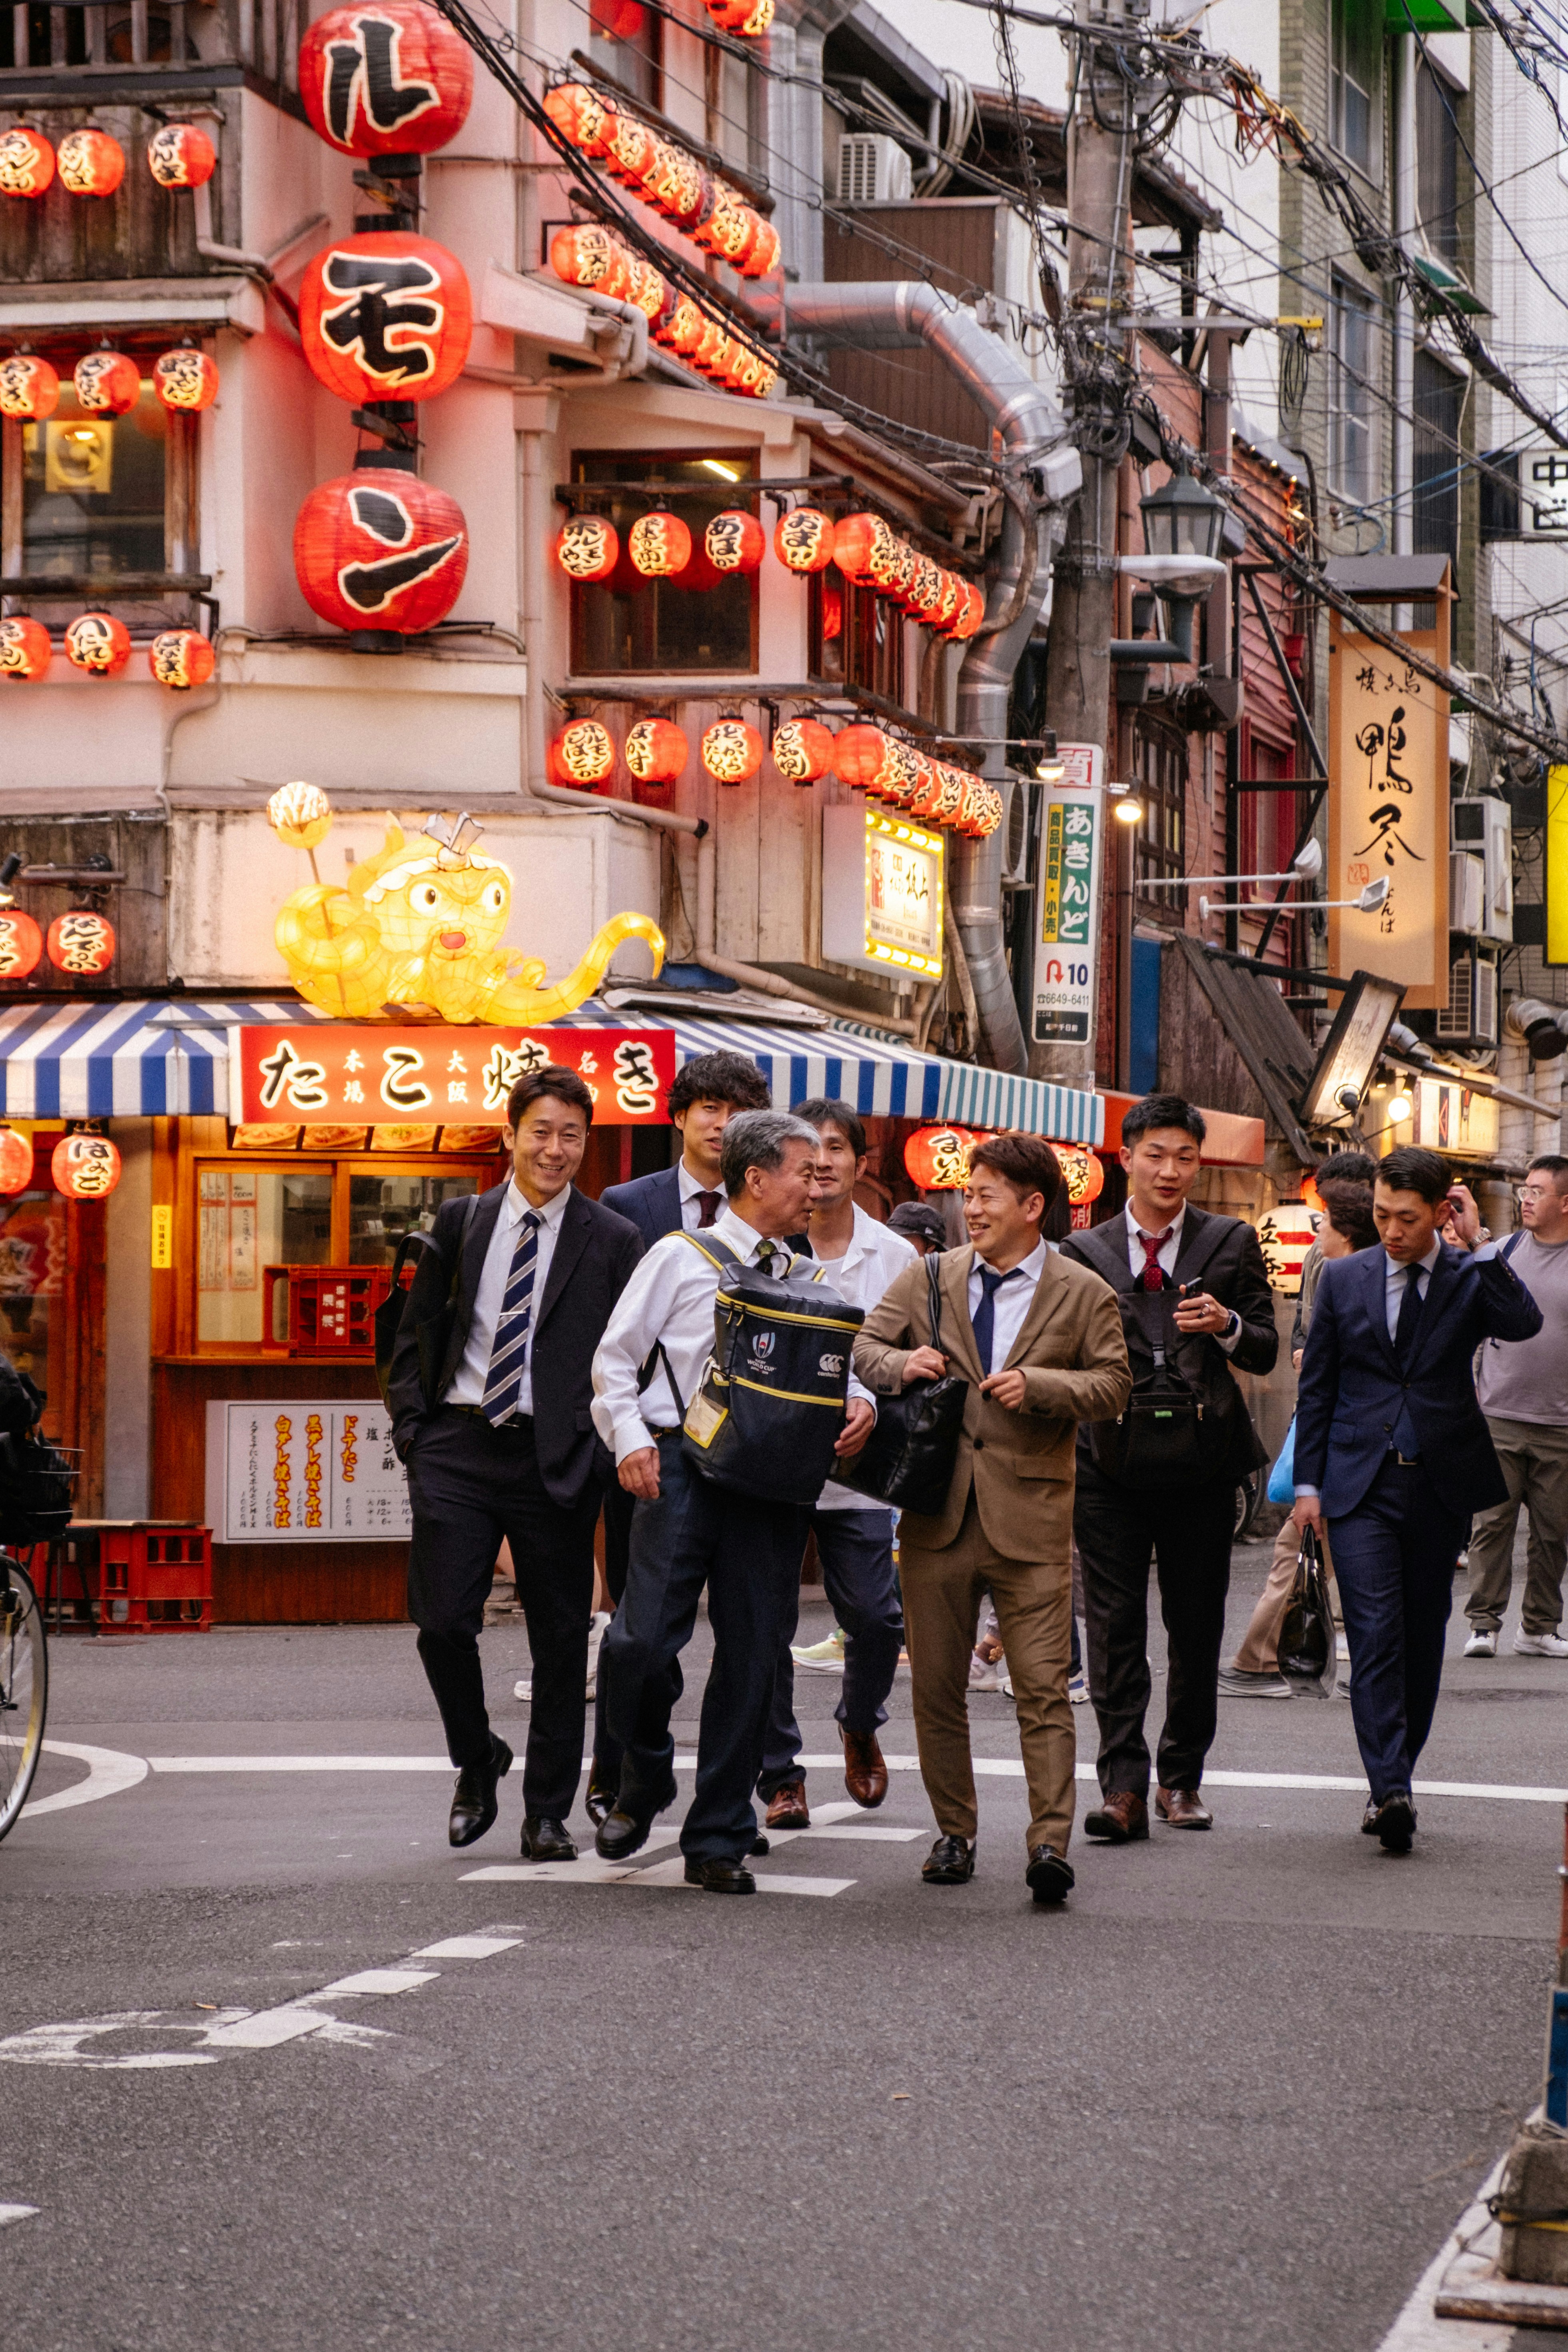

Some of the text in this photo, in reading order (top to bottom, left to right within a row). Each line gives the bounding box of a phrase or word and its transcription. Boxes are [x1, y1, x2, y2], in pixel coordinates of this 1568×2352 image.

[707, 516, 740, 567] あほか
[1059, 806, 1092, 940] あきんど
[1046, 993, 1089, 1006] 6649-6411
[1068, 963, 1088, 986] 10
[343, 1049, 365, 1104] 本場
[447, 1049, 468, 1104] 大阪
[931, 1133, 961, 1183] まいど
[747, 1359, 764, 1369] WORLD
[341, 1415, 358, 1482] ドテたこ
[366, 1427, 378, 1441] 塩
